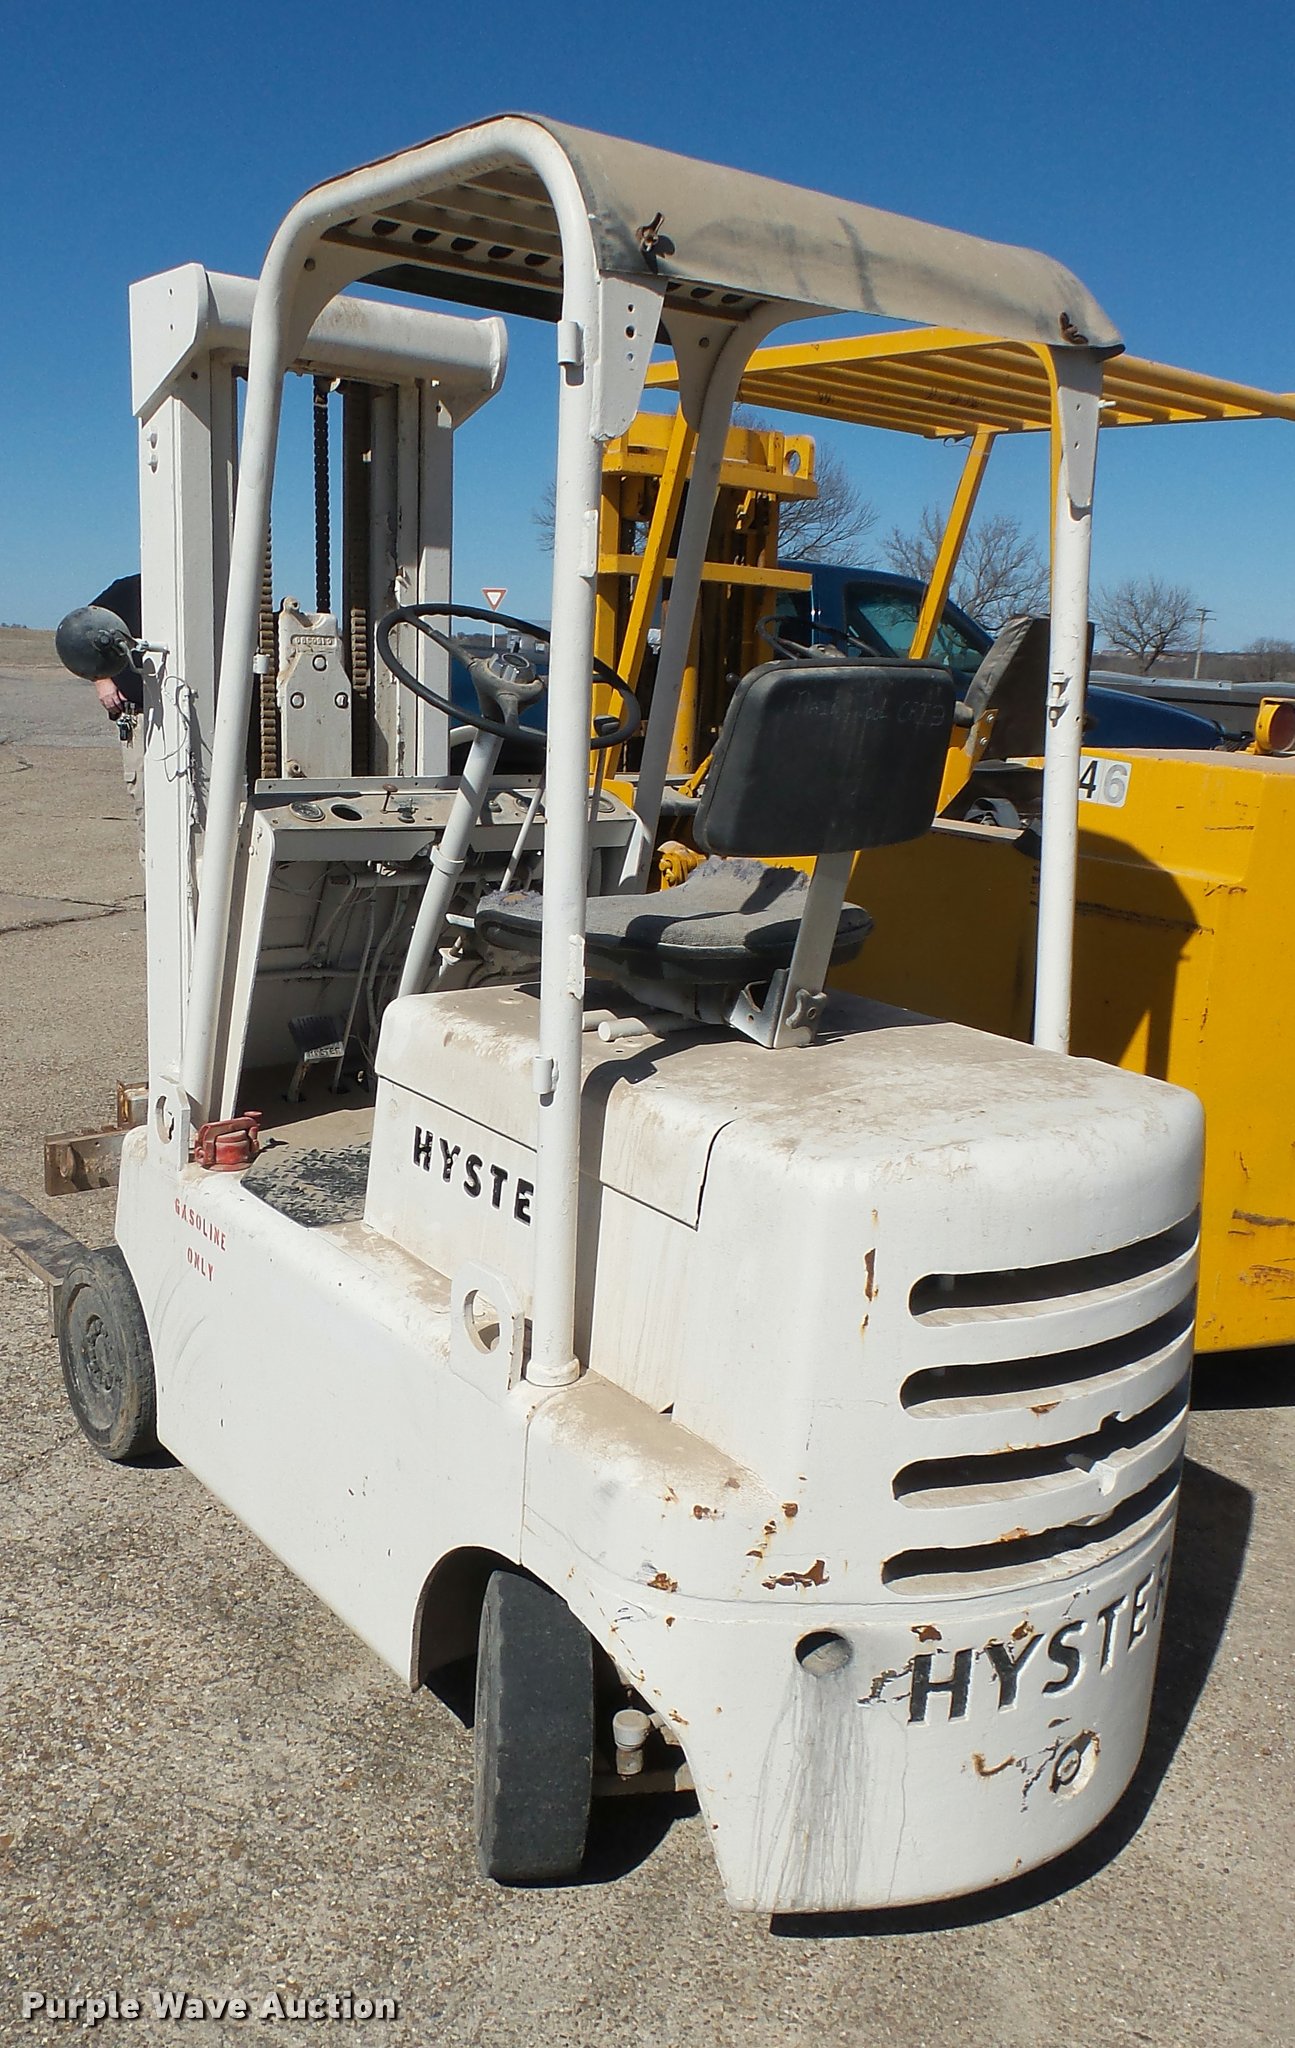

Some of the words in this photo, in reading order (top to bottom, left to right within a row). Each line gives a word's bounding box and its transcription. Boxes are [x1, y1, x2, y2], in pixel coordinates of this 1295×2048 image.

[413, 1125, 534, 1226] HYSTE
[174, 1198, 226, 1251] GASOLINE
[187, 1247, 213, 1281] ONLY
